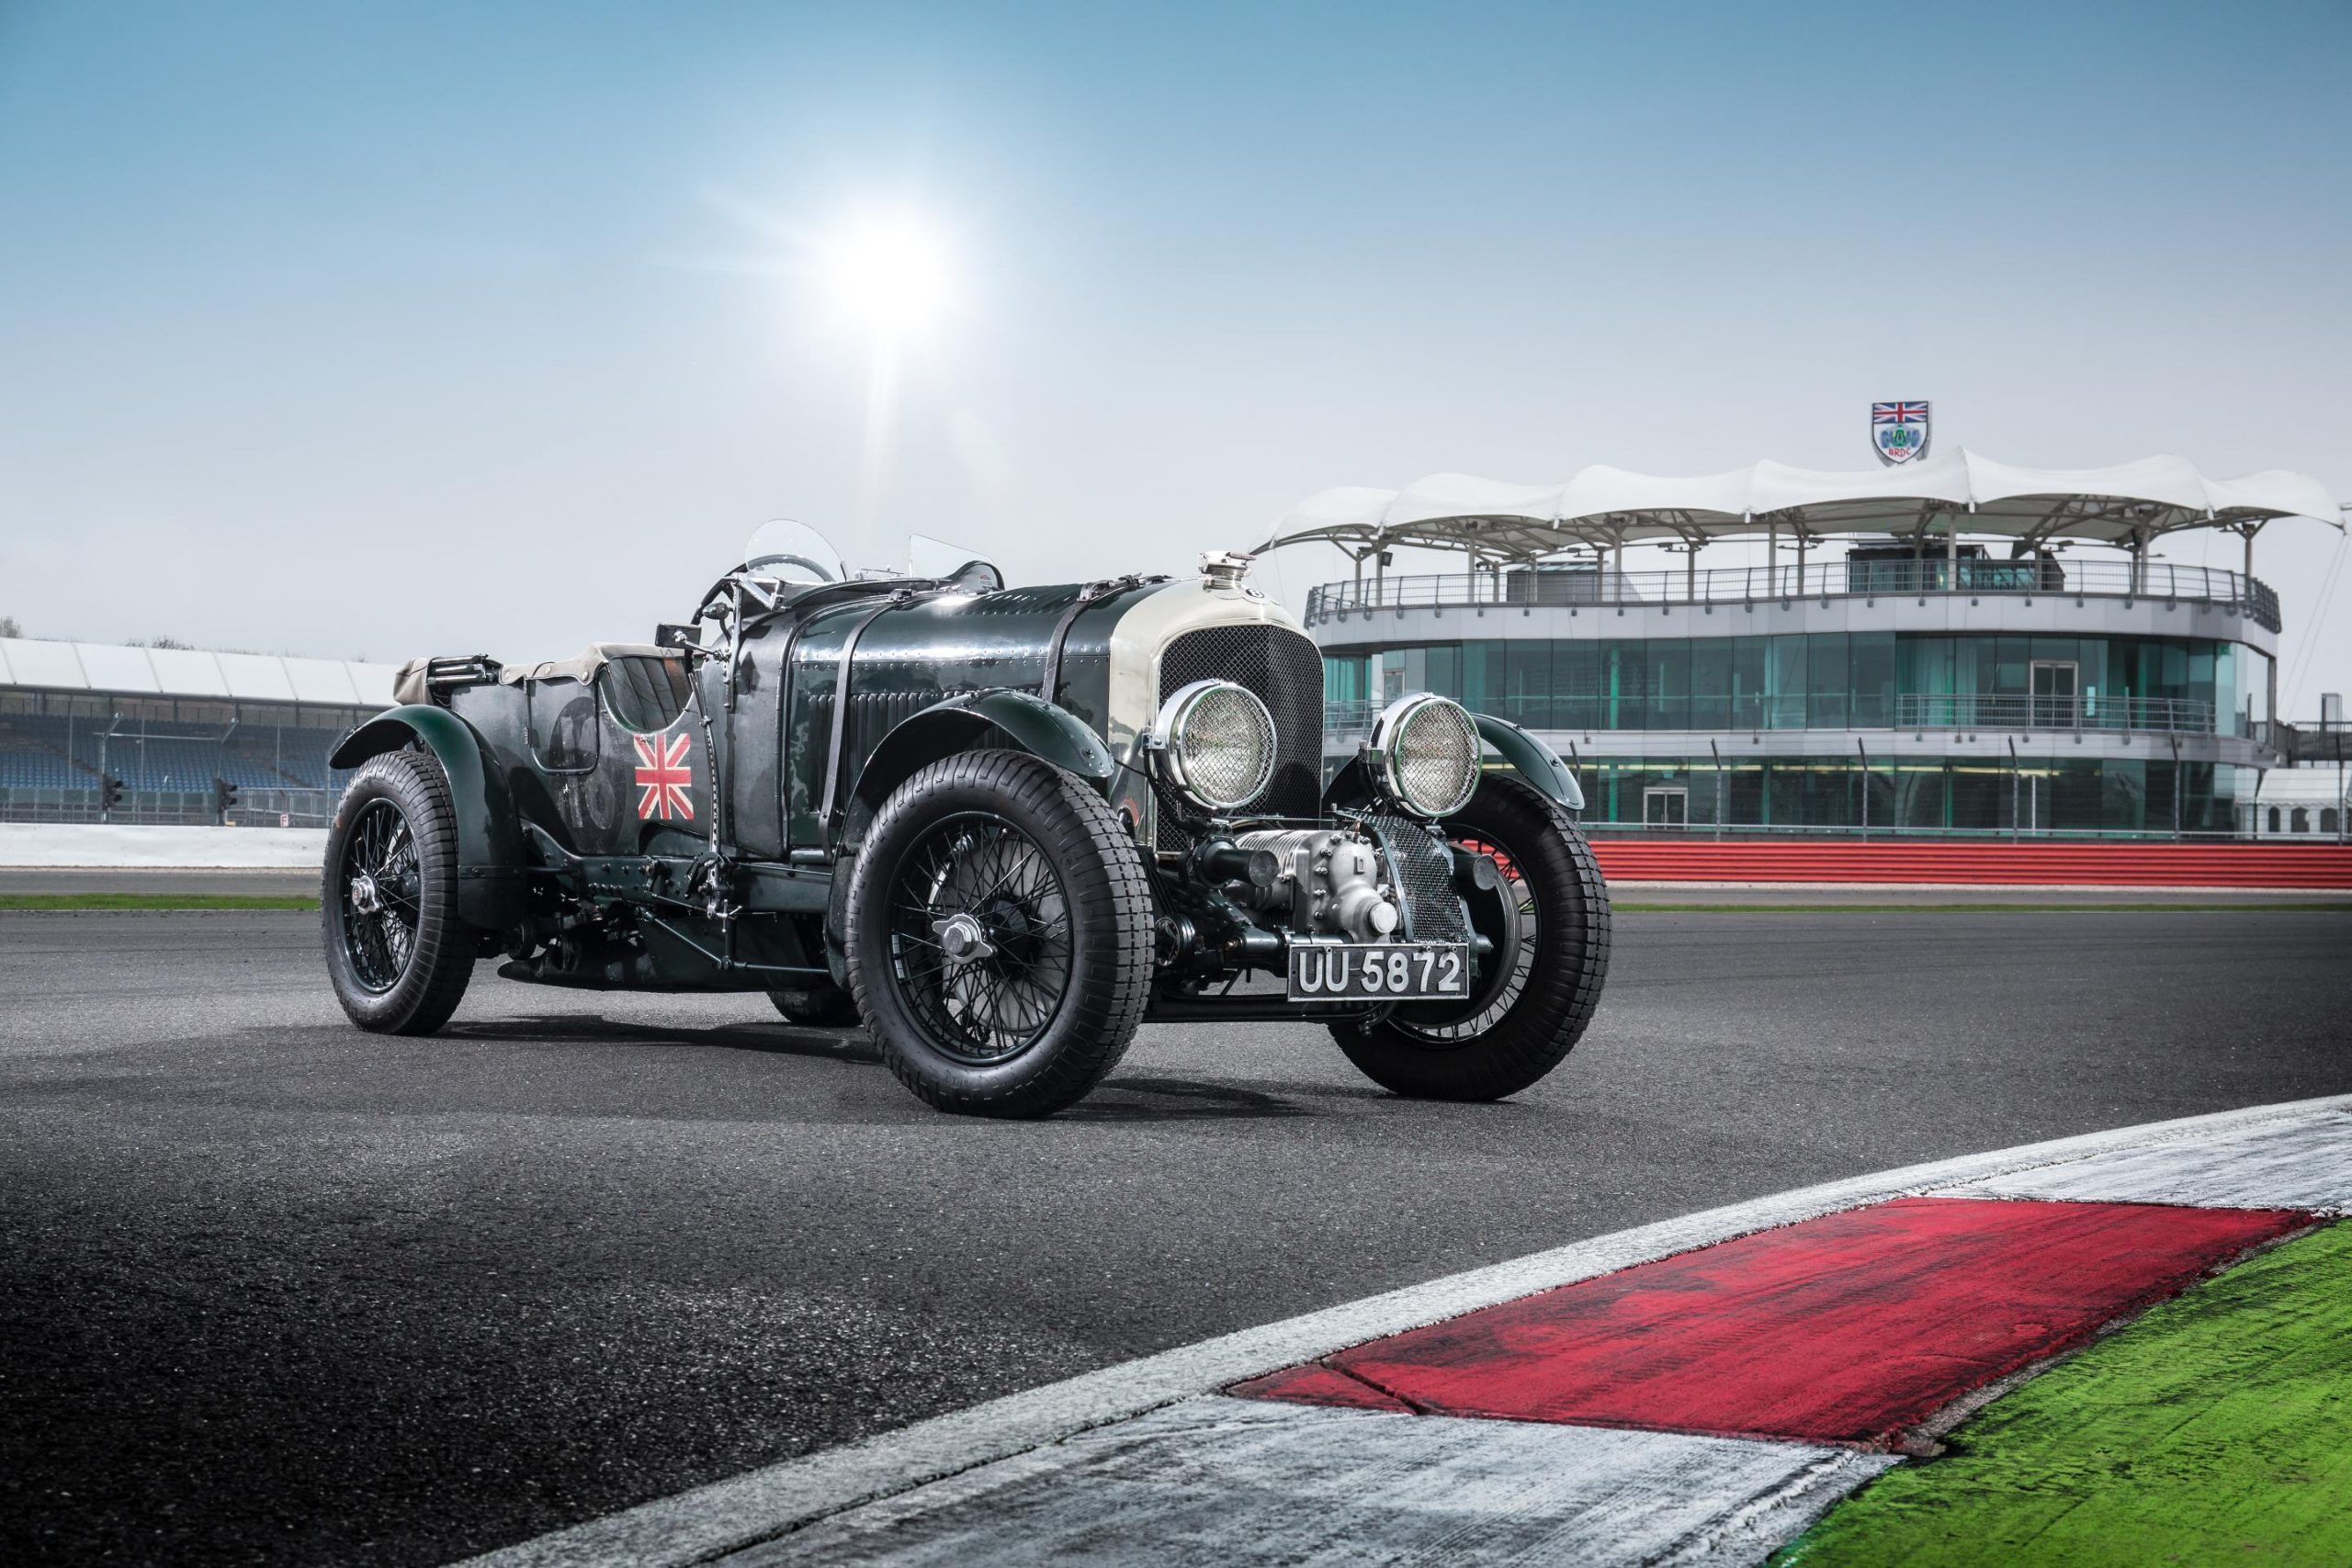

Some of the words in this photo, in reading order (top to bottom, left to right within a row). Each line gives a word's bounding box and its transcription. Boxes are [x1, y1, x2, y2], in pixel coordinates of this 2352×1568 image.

[1888, 447, 1911, 457] BRDC
[1299, 952, 1350, 993] UU
[1361, 951, 1461, 993] 5872
